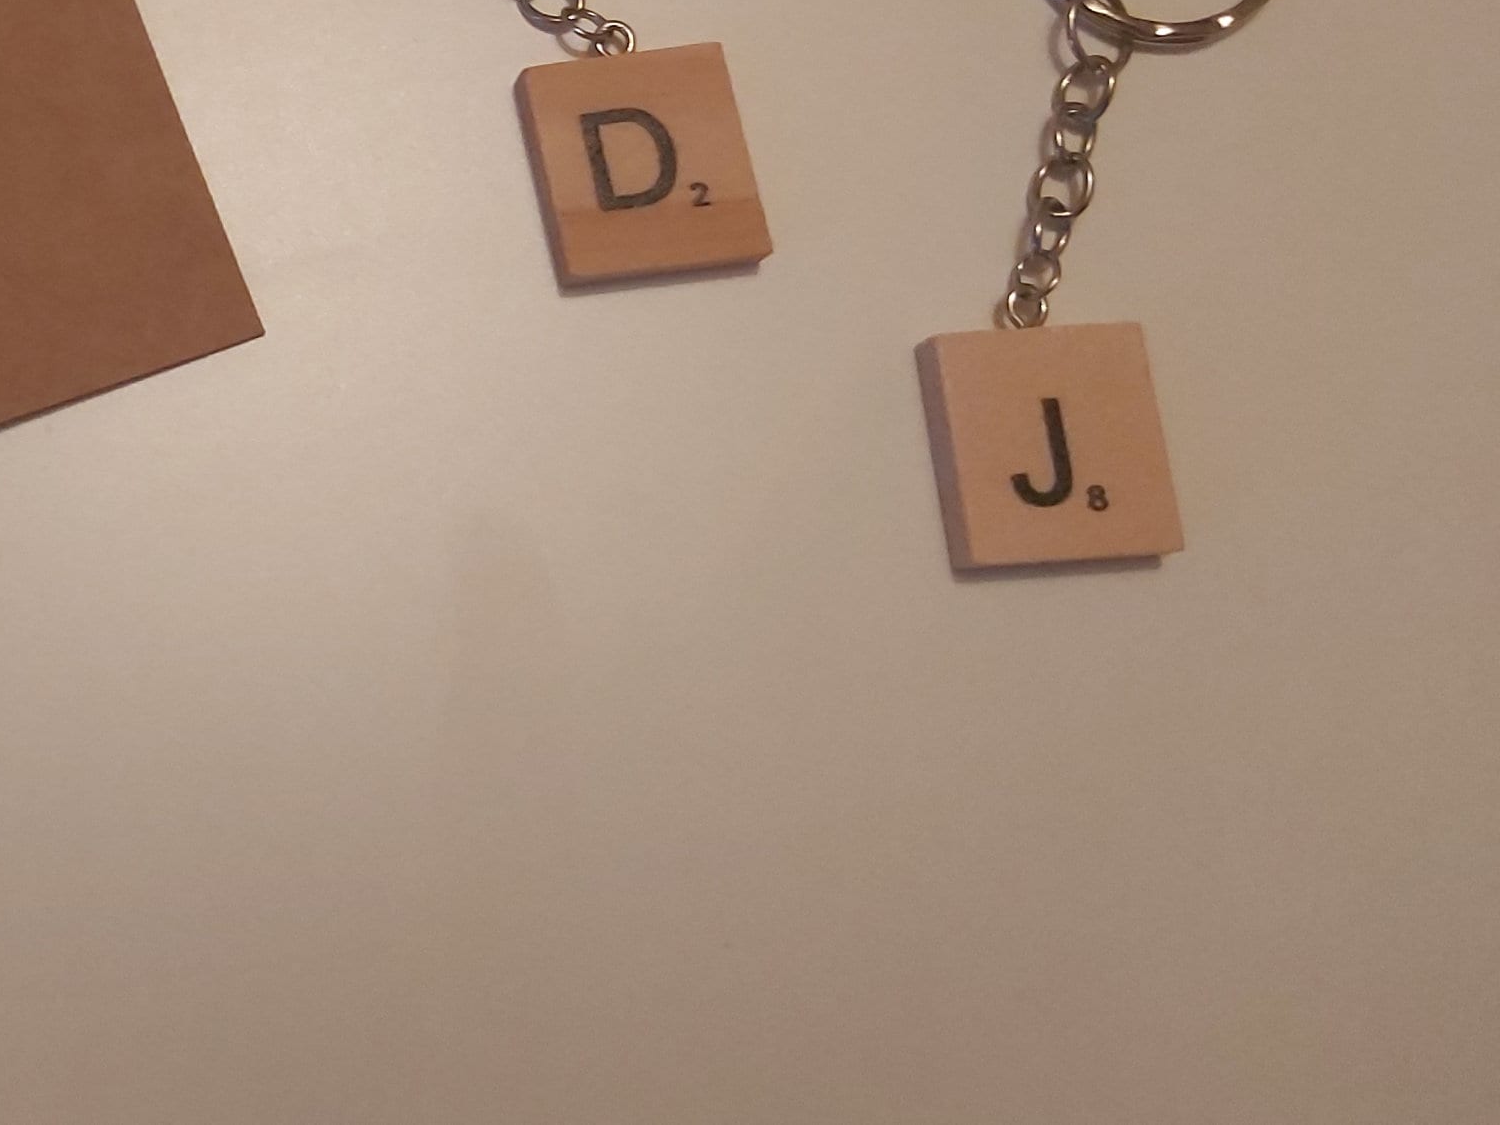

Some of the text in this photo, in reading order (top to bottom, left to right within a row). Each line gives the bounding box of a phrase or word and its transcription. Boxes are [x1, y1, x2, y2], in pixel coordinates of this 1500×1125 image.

[578, 107, 713, 214] D 2
[1009, 397, 1110, 513] J 8
